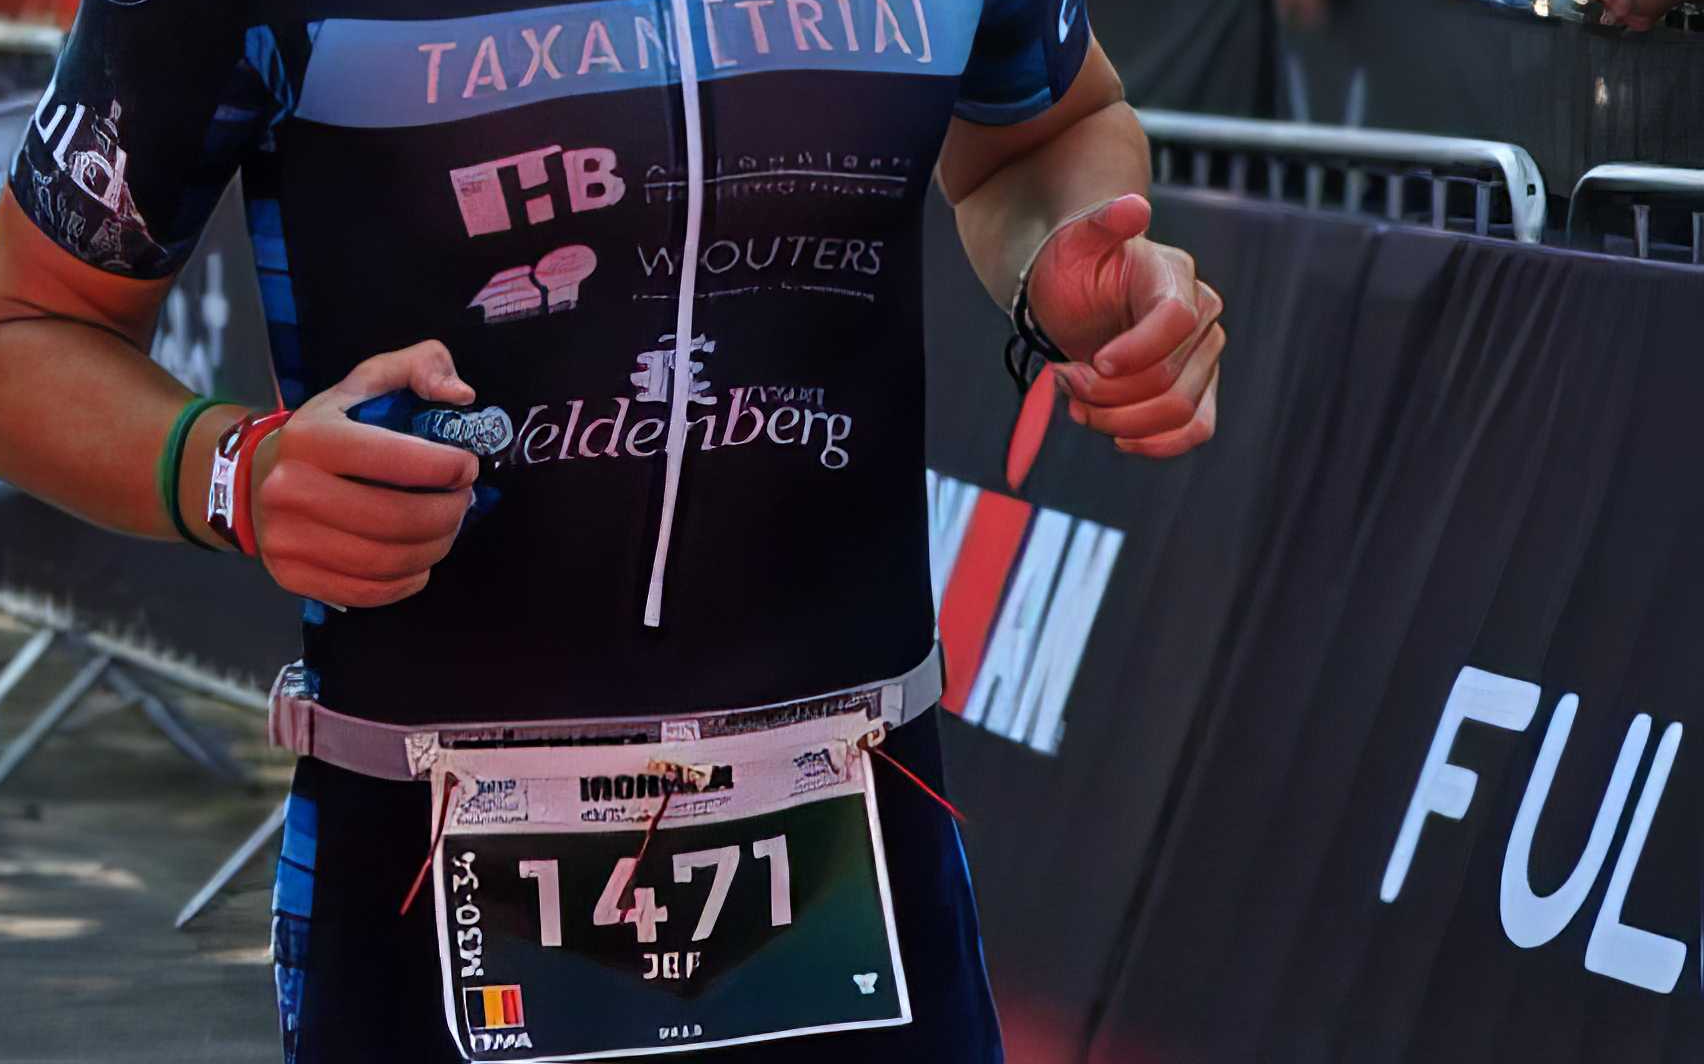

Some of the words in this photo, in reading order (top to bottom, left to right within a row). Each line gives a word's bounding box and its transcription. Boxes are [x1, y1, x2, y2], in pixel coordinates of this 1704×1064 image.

[637, 236, 885, 277] WOUTERS
[1379, 665, 1704, 994] FUL
[518, 834, 793, 947] 1471
